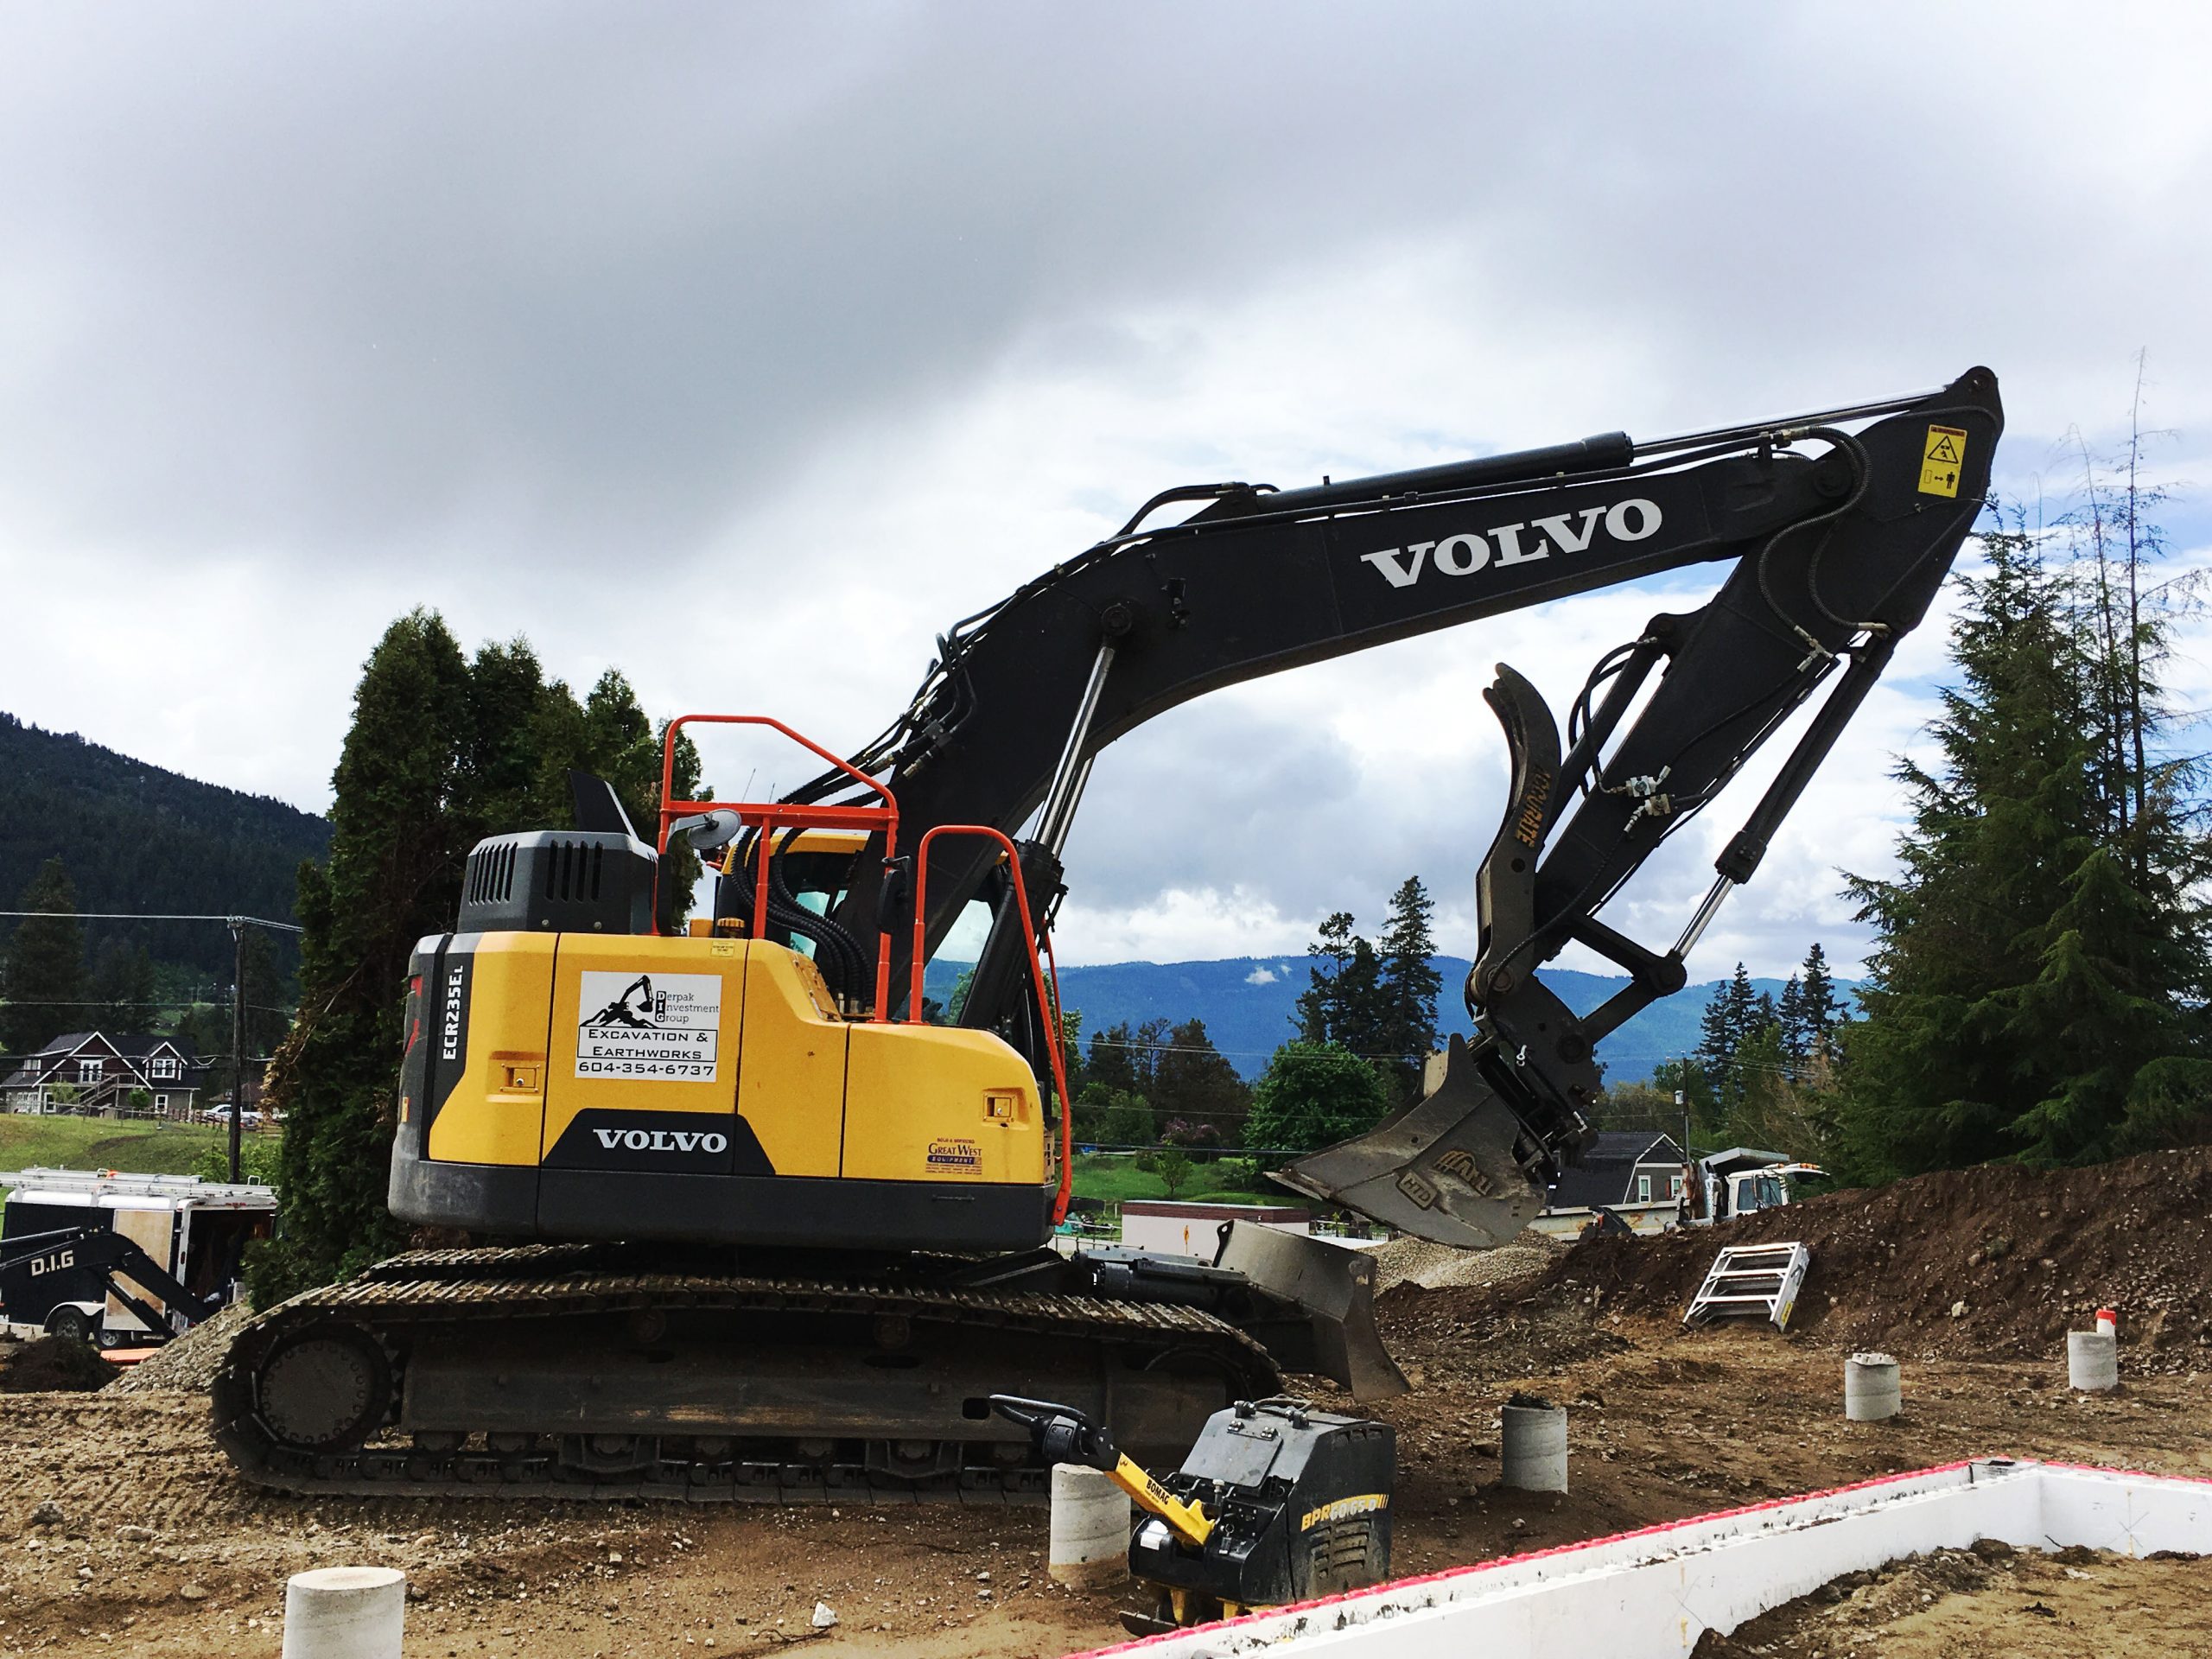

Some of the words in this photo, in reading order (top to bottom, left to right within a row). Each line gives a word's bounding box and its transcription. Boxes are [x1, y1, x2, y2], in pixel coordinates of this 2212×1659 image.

[1360, 499, 1662, 588] VOLVO
[657, 991, 695, 1002] Derpak
[658, 1002, 720, 1013] Investment
[656, 1013, 690, 1024] Group
[588, 1028, 689, 1042] EXCAVATION
[696, 1033, 709, 1042] &
[593, 1046, 702, 1059] EARTHWORKS
[579, 1062, 714, 1076] 604-354-6737
[593, 1128, 728, 1154] VOLVO
[928, 1142, 957, 1155] GREAT
[957, 1144, 982, 1156] WEST
[1402, 1177, 1432, 1202] HTD
[31, 1249, 74, 1277] D.I.G
